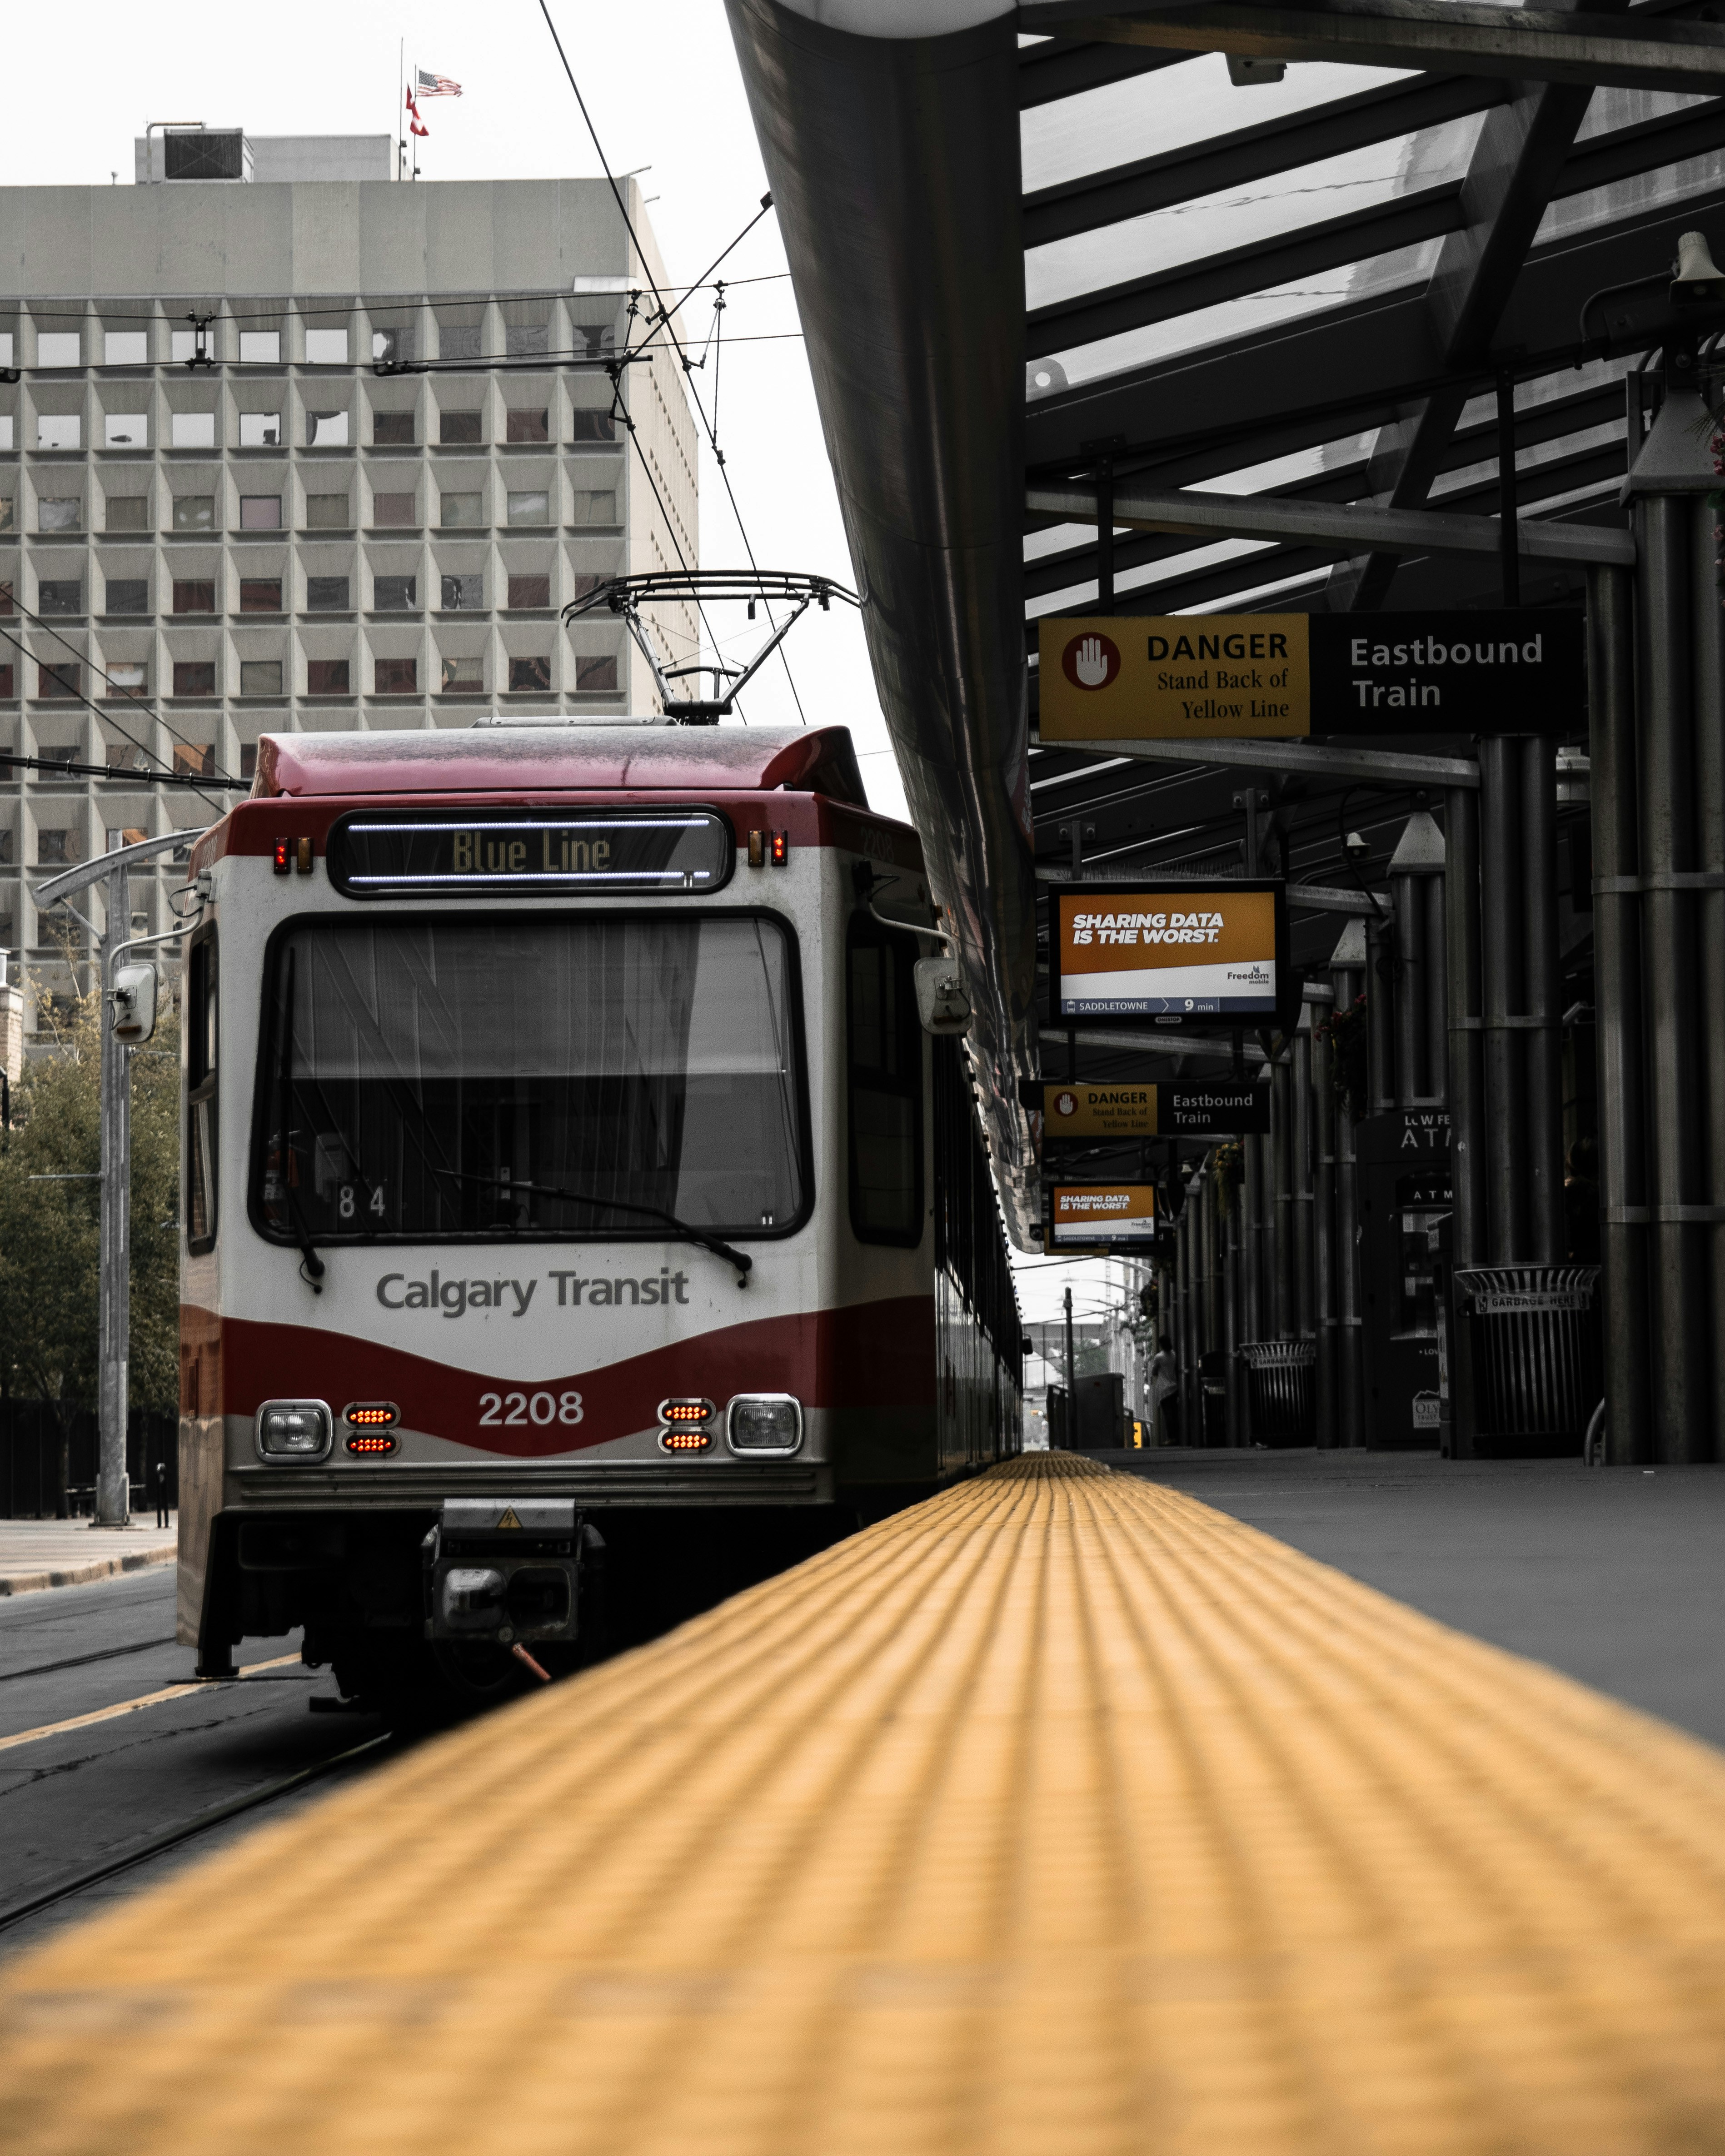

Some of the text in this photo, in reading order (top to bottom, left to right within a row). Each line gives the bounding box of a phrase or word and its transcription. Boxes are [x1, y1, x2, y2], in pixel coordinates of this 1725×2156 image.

[1148, 633, 1288, 662] DANGER
[1351, 633, 1542, 666] Eastbound
[1157, 668, 1289, 691] Stand Back of
[1352, 677, 1441, 707] Train
[1182, 700, 1290, 720] Yellow Line
[453, 829, 611, 872] Blue Line
[858, 826, 894, 864] 2208
[1072, 913, 1224, 929] SHARING DATA
[1073, 928, 1219, 945] IS THE WORST.
[1227, 971, 1269, 980] Freedom
[1079, 1001, 1148, 1011] SADDLETOWNE
[1184, 999, 1194, 1011] 9
[1088, 1092, 1147, 1104] DANGER
[1173, 1093, 1253, 1107] Eastbound
[1092, 1107, 1148, 1116] Stand Back of
[1174, 1112, 1211, 1124] Train
[1102, 1120, 1148, 1128] Yellow Line
[376, 1267, 690, 1319] Calgary Transit
[1492, 1295, 1575, 1307] GARBAGE HERE
[479, 1391, 584, 1426] 2208
